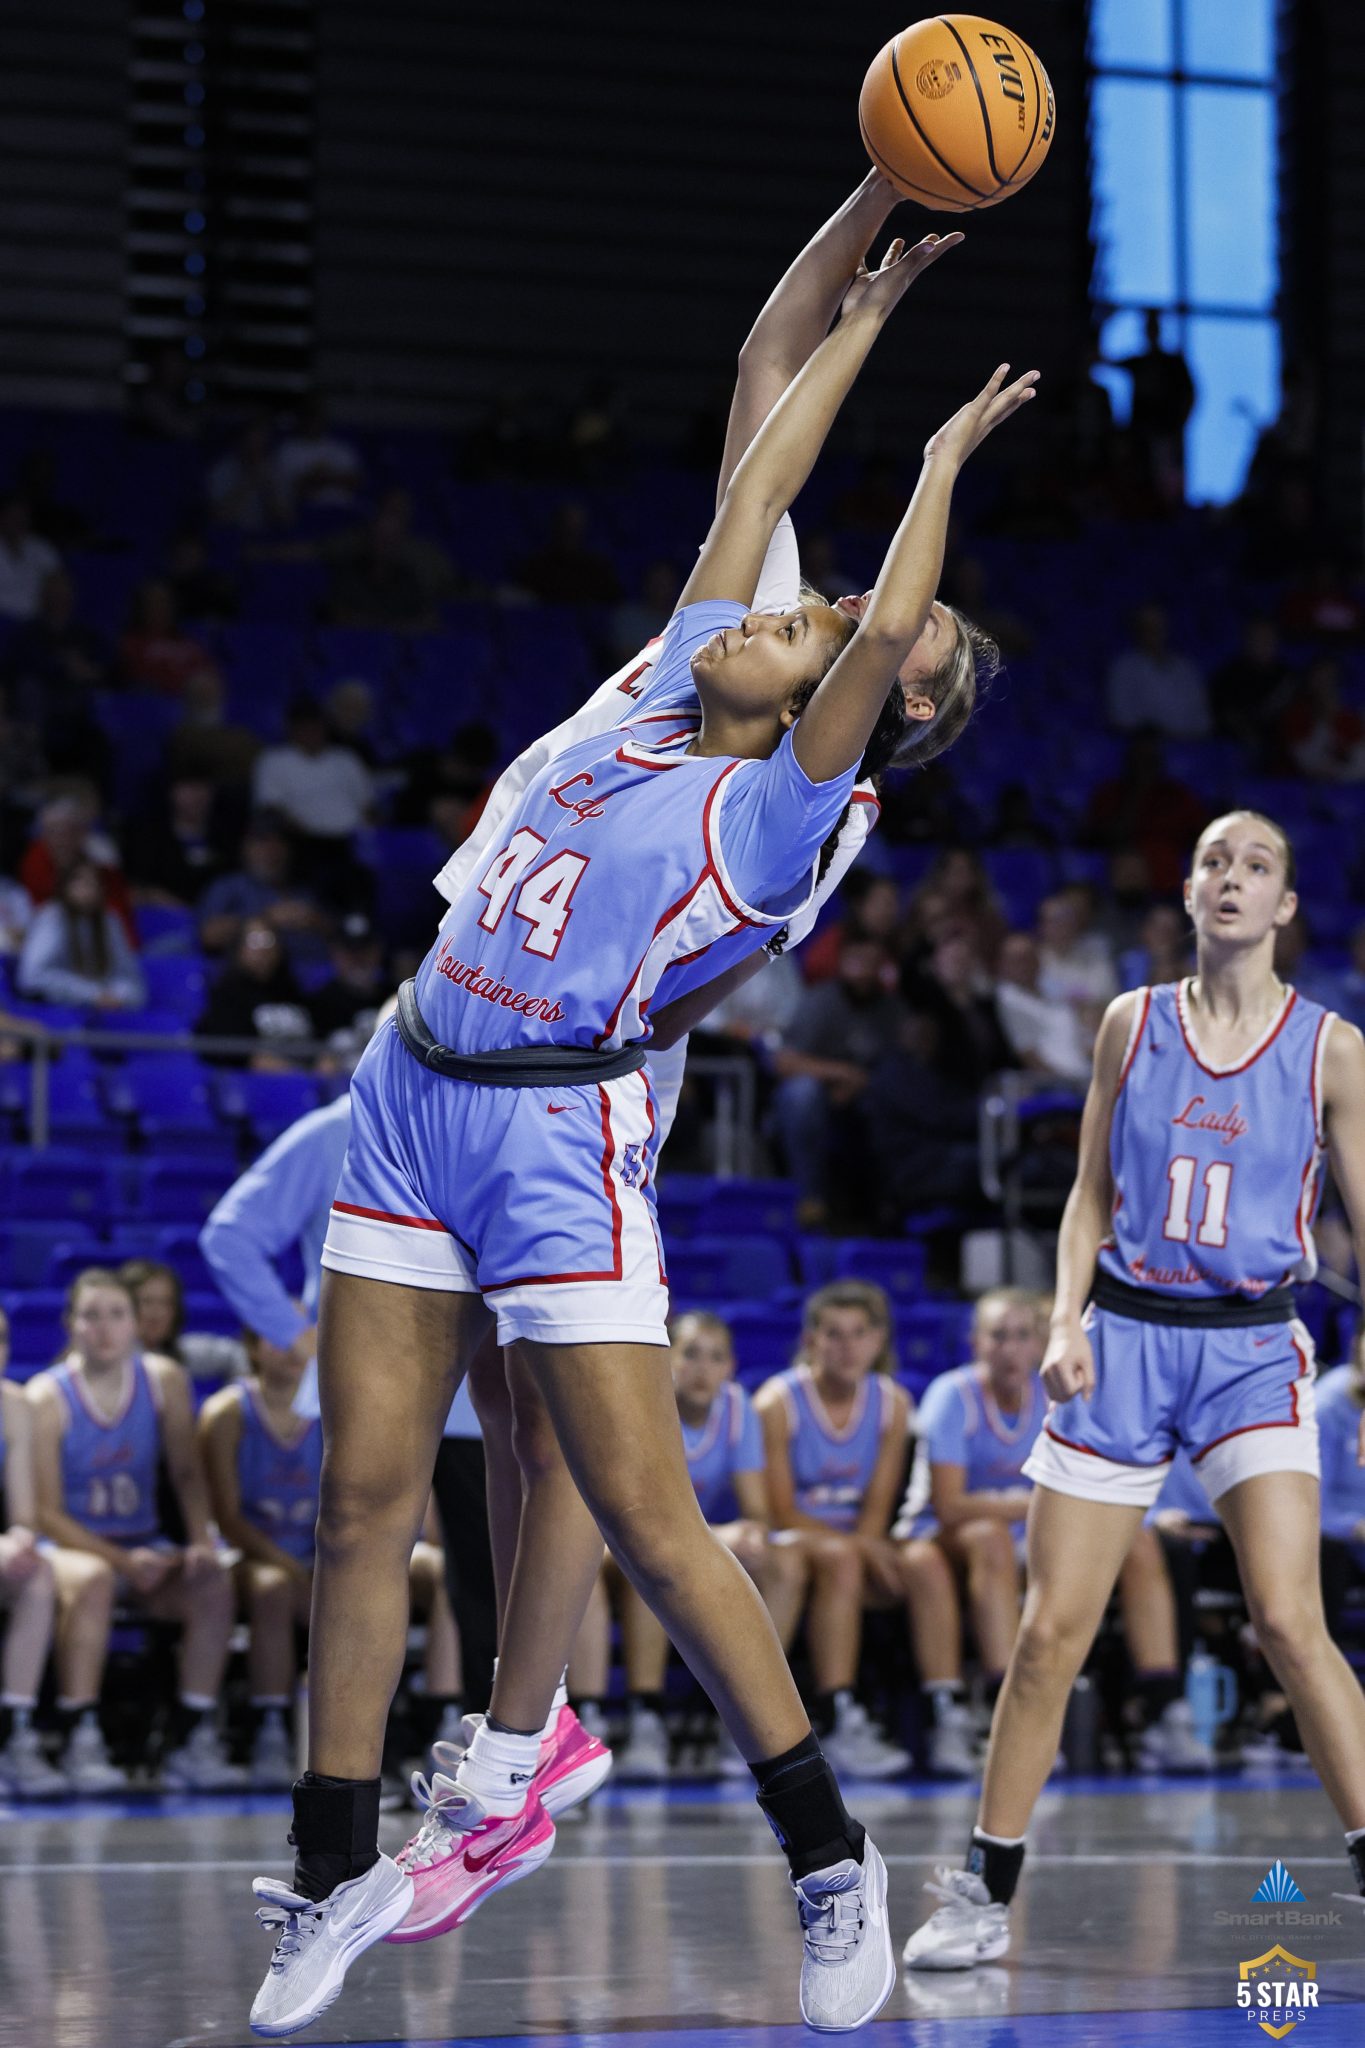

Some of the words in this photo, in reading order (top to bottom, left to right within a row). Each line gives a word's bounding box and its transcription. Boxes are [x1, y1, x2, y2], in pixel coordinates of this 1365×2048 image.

[979, 32, 1025, 103] EVO
[1171, 1095, 1248, 1146] Lady
[1162, 1154, 1234, 1249] 11
